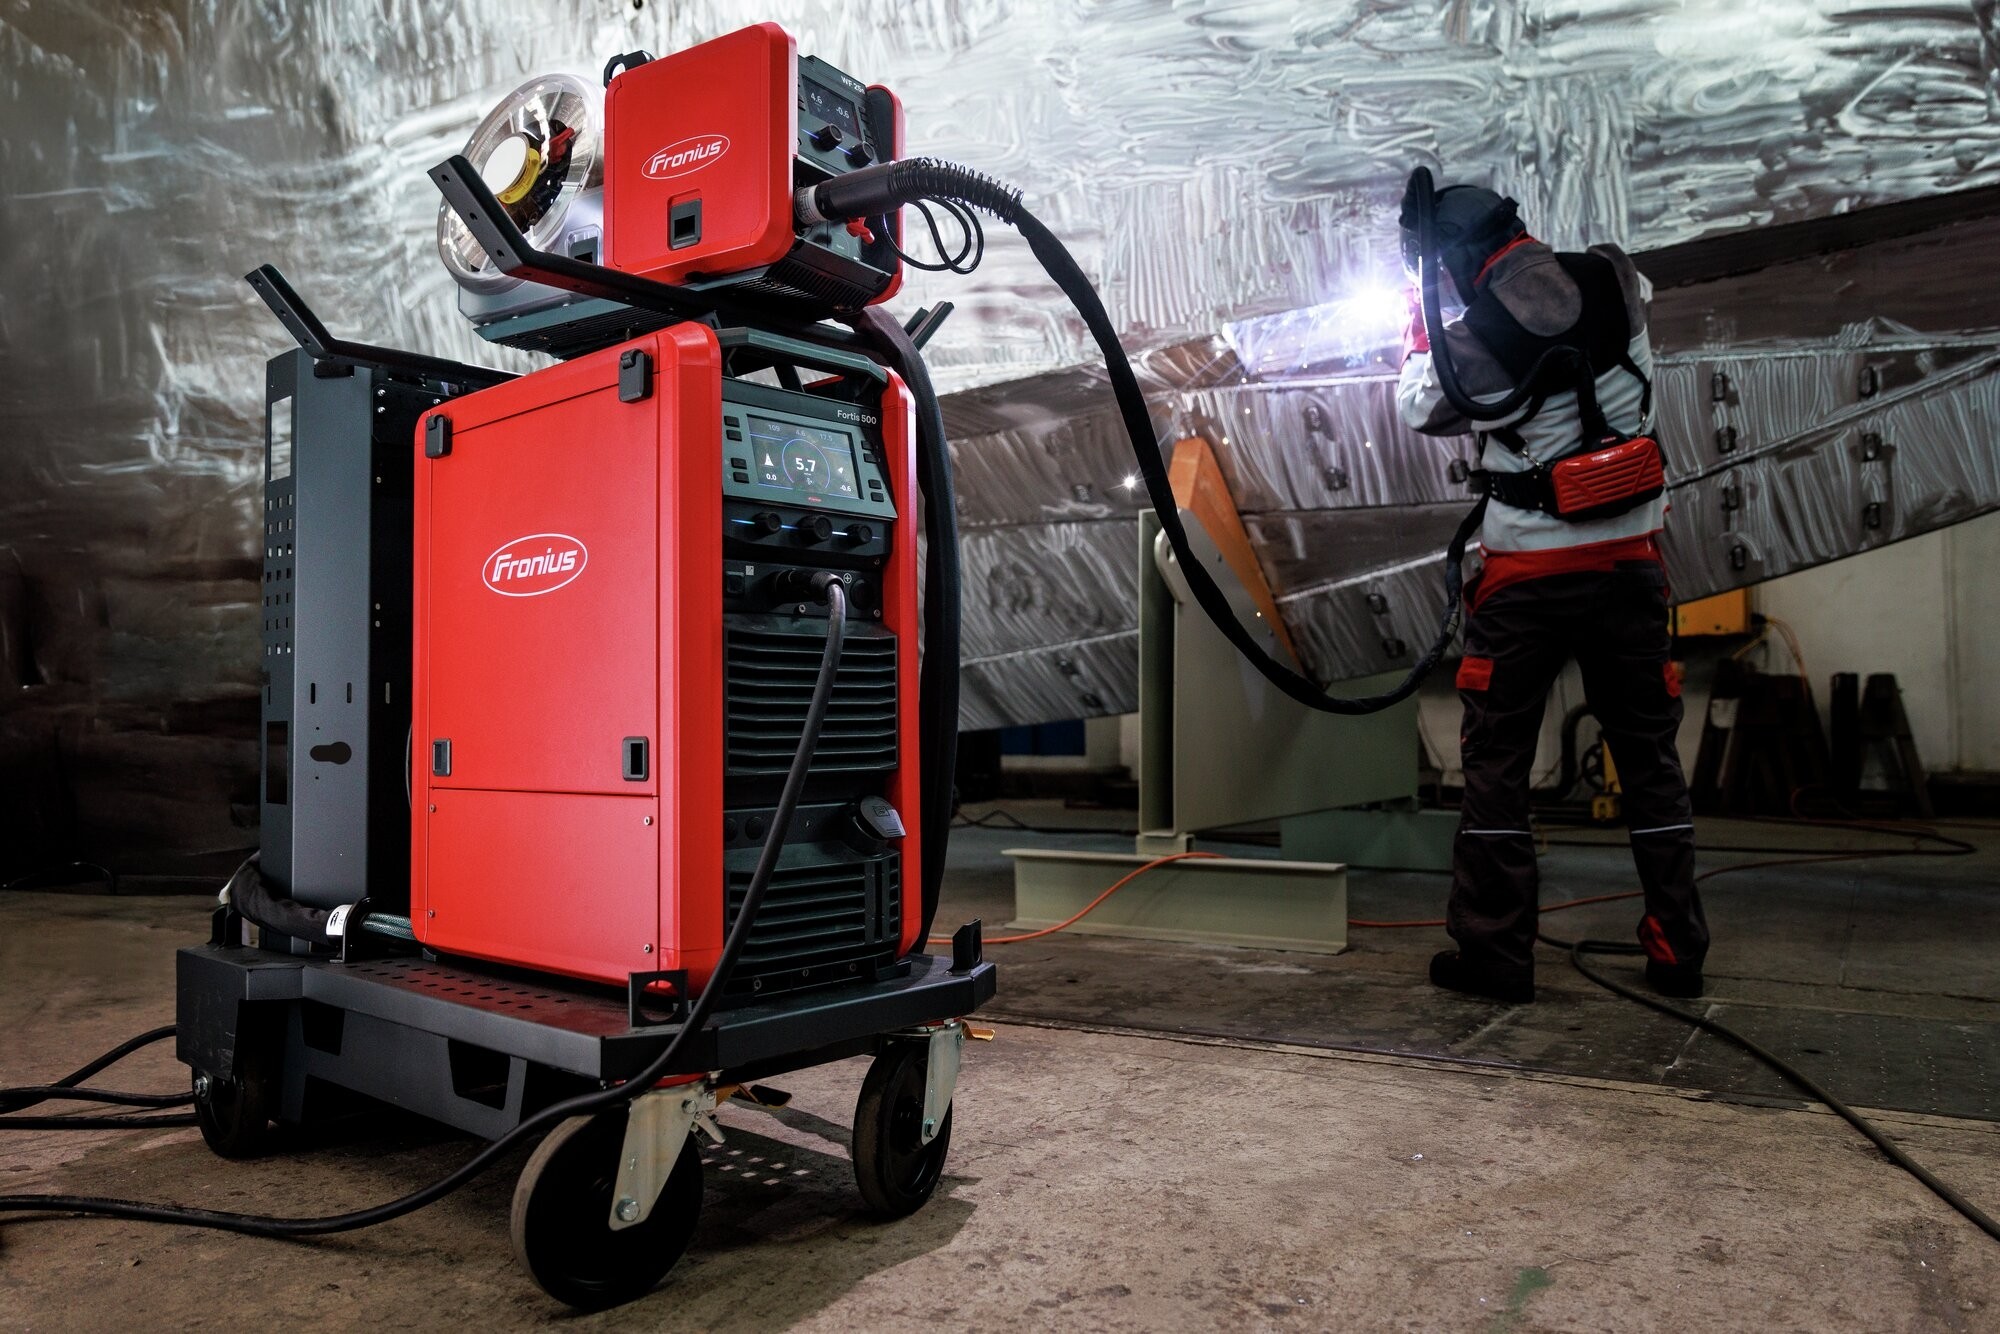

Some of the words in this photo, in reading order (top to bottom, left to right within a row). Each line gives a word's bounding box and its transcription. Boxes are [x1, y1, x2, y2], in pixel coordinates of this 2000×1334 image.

[811, 92, 823, 104] 4.6
[649, 140, 722, 175] Fronius
[837, 409, 860, 421] Fortis
[861, 414, 877, 425] 500
[795, 457, 816, 472] 5.7
[765, 473, 777, 481] 0.0
[491, 547, 579, 583] Fronius
